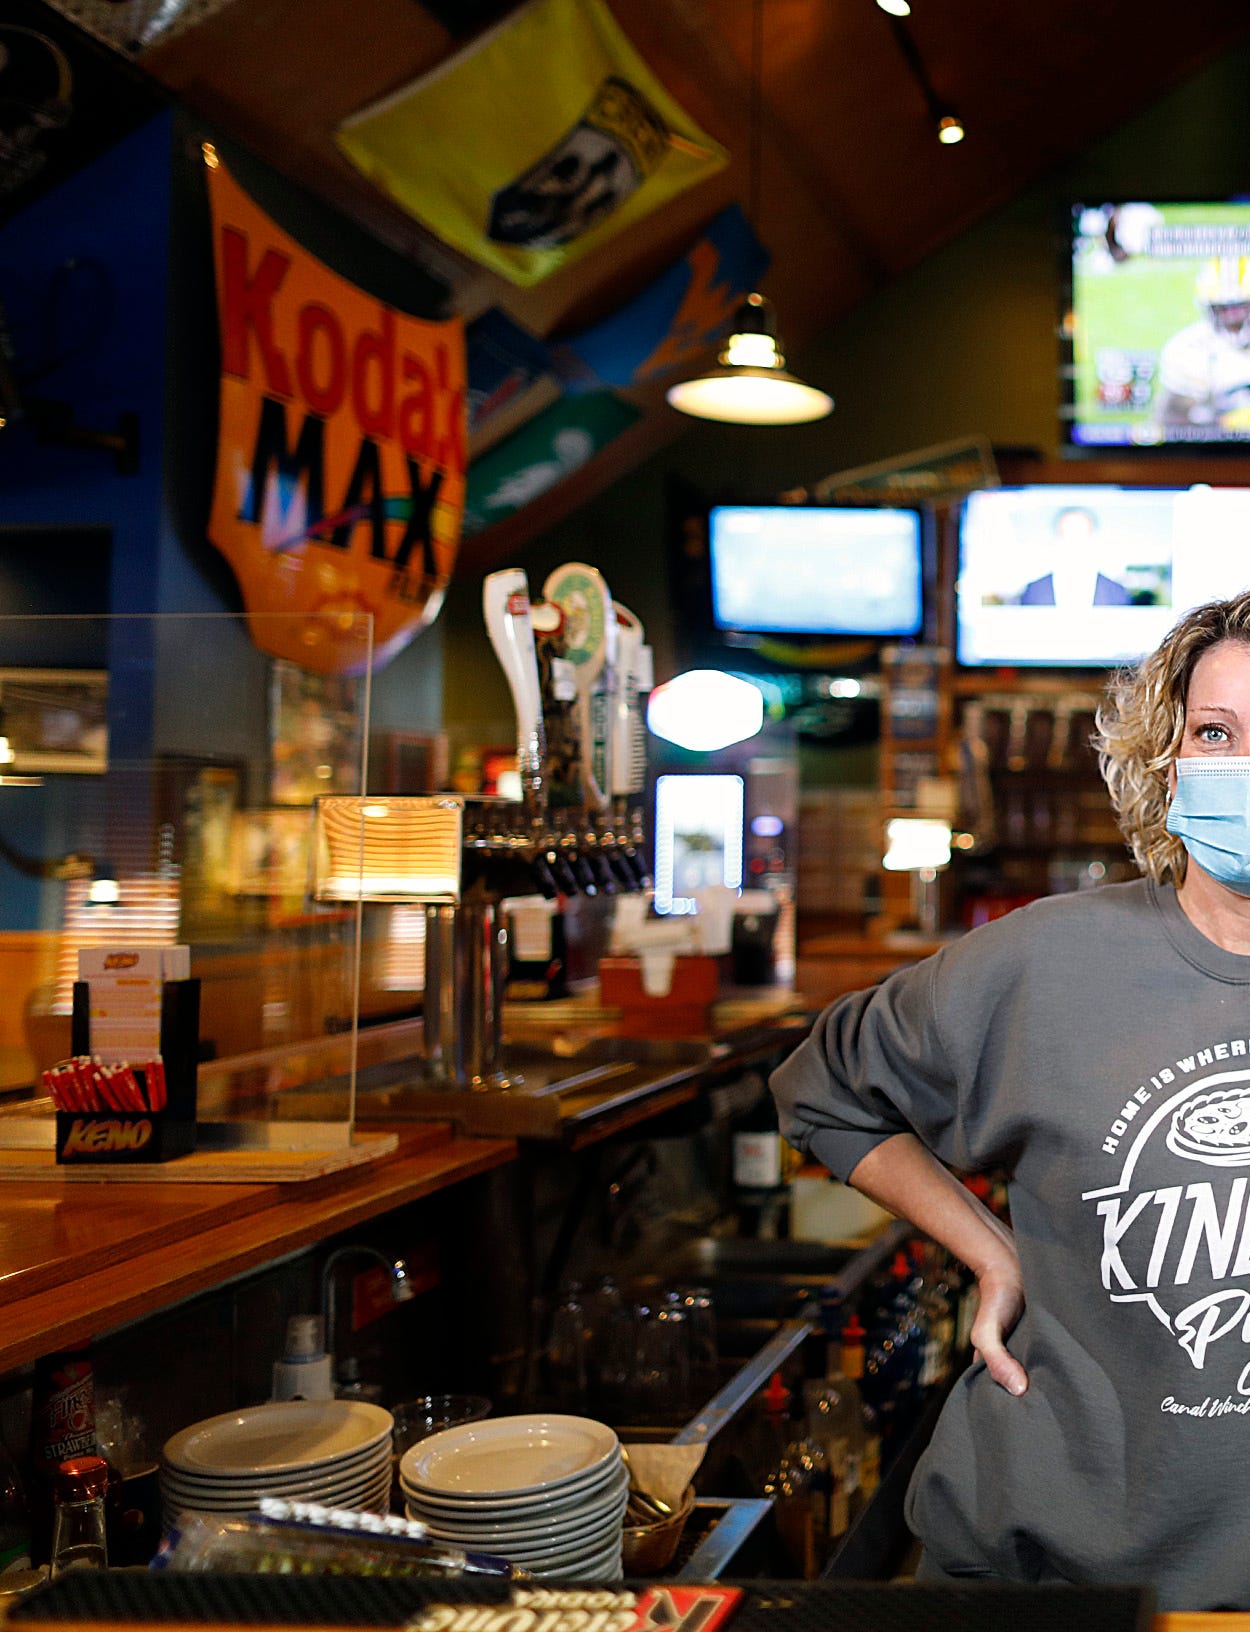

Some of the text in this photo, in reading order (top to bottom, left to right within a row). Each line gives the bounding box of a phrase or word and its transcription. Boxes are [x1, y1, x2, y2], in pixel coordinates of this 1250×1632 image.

[239, 397, 444, 575] MAX
[62, 1119, 152, 1157] KENO
[1102, 1087, 1151, 1155] HOME
[1151, 1067, 1176, 1090] IS
[1160, 1396, 1211, 1417] Canal
